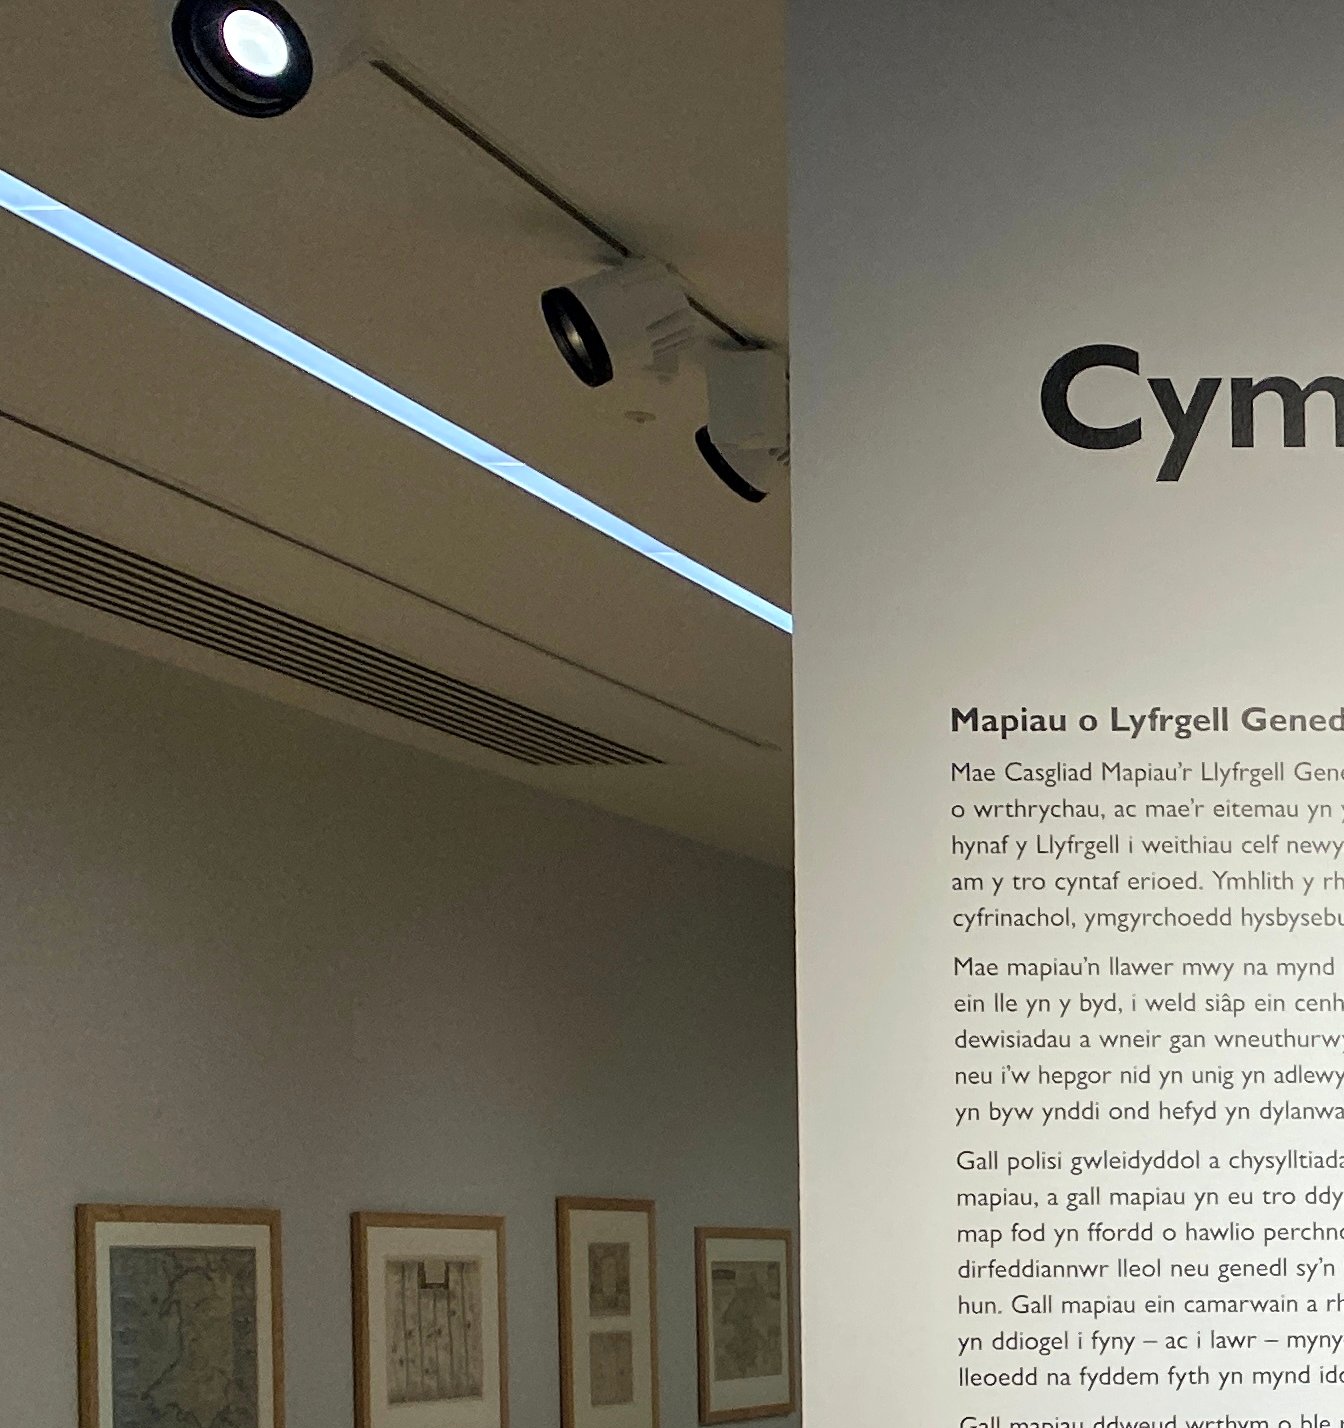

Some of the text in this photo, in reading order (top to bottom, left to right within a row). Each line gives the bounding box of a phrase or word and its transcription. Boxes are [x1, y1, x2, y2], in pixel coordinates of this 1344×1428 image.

[951, 706, 1067, 741] Mapiau
[1078, 714, 1098, 732] o
[1110, 706, 1229, 740] Lyfrgell
[951, 761, 996, 782] Mae
[1004, 761, 1093, 788] Casgliad
[1201, 761, 1284, 788] Llyfrgell
[952, 906, 1076, 933] cyfrinachol,
[1083, 906, 1233, 933] ymgyrchoedd
[959, 1366, 1038, 1387] lleoedd
[1047, 1372, 1072, 1386] na
[1078, 1365, 1159, 1392] fyddem
[1167, 1364, 1210, 1392] fyth
[1217, 1370, 1243, 1391] yn
[1252, 1364, 1311, 1391] mynd
